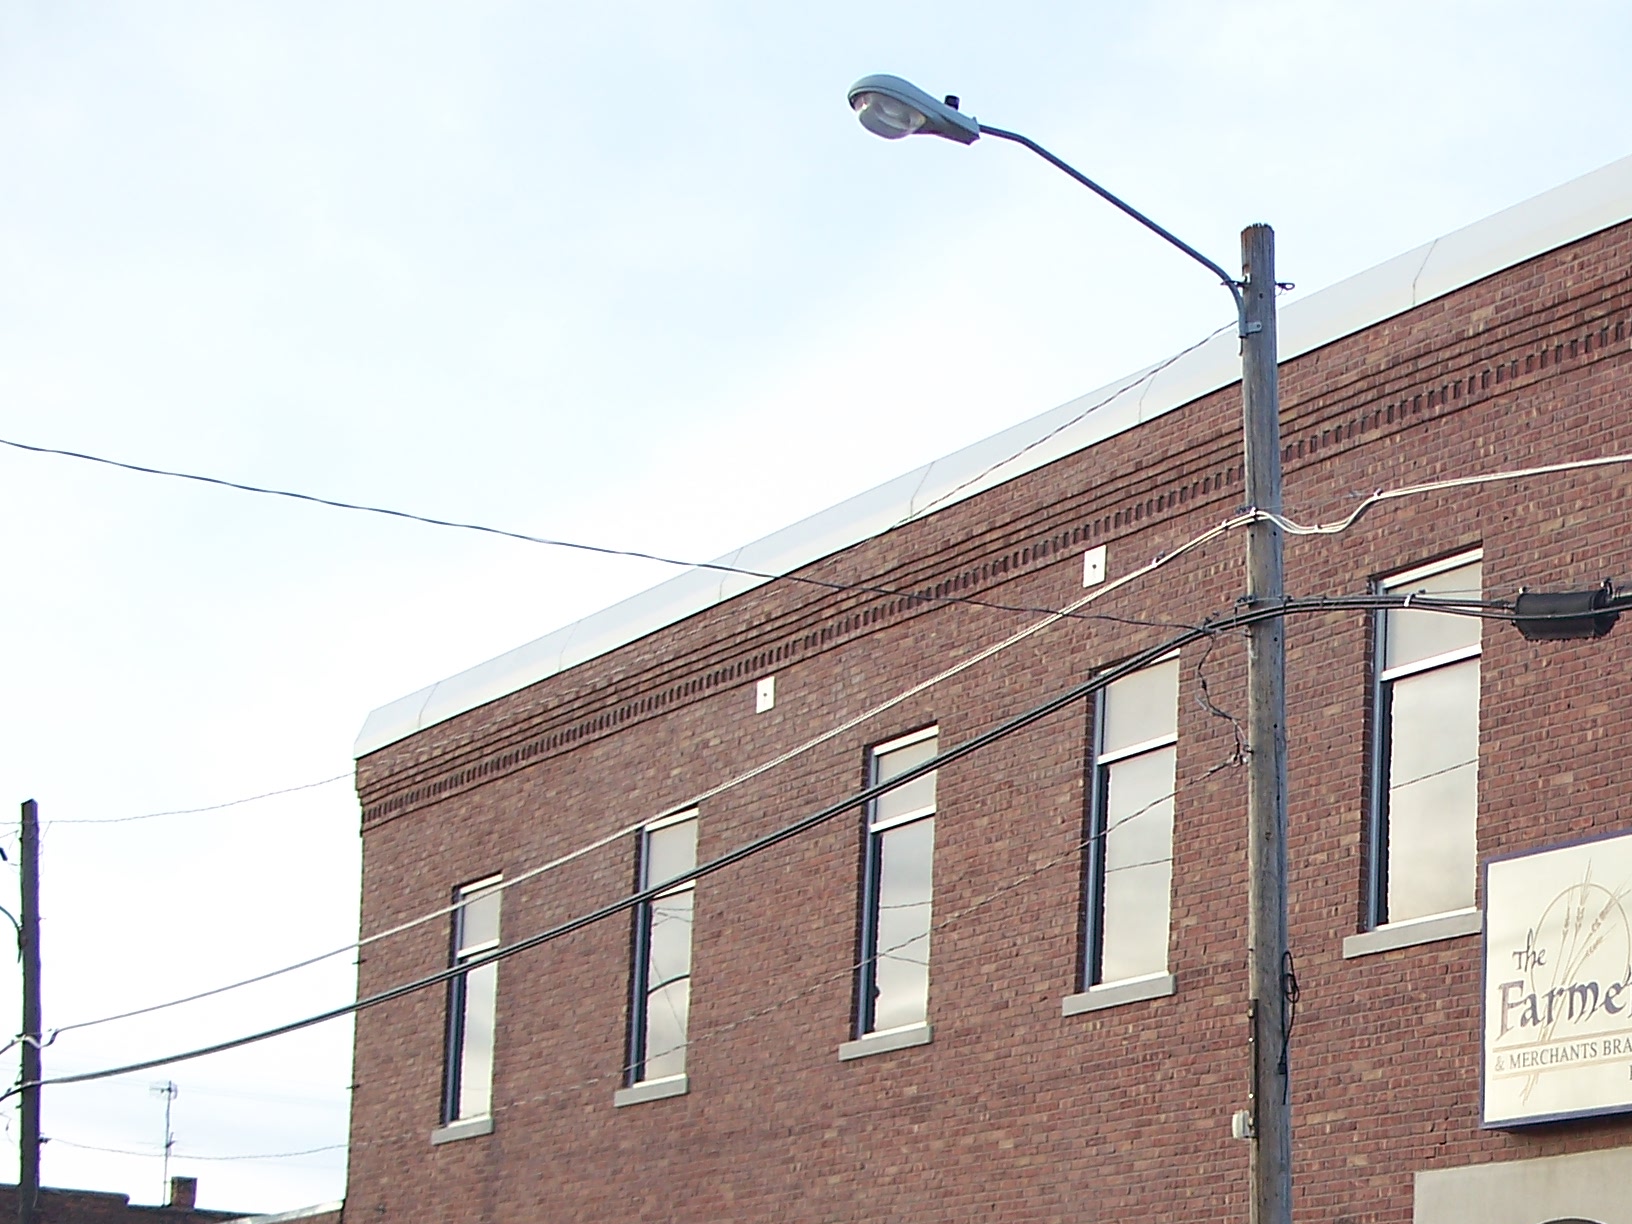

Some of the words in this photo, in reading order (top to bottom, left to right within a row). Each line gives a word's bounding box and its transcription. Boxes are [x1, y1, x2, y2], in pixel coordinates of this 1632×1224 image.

[1512, 927, 1547, 972] The
[1494, 1054, 1506, 1071] &
[1508, 1041, 1598, 1070] MERCHANTS
